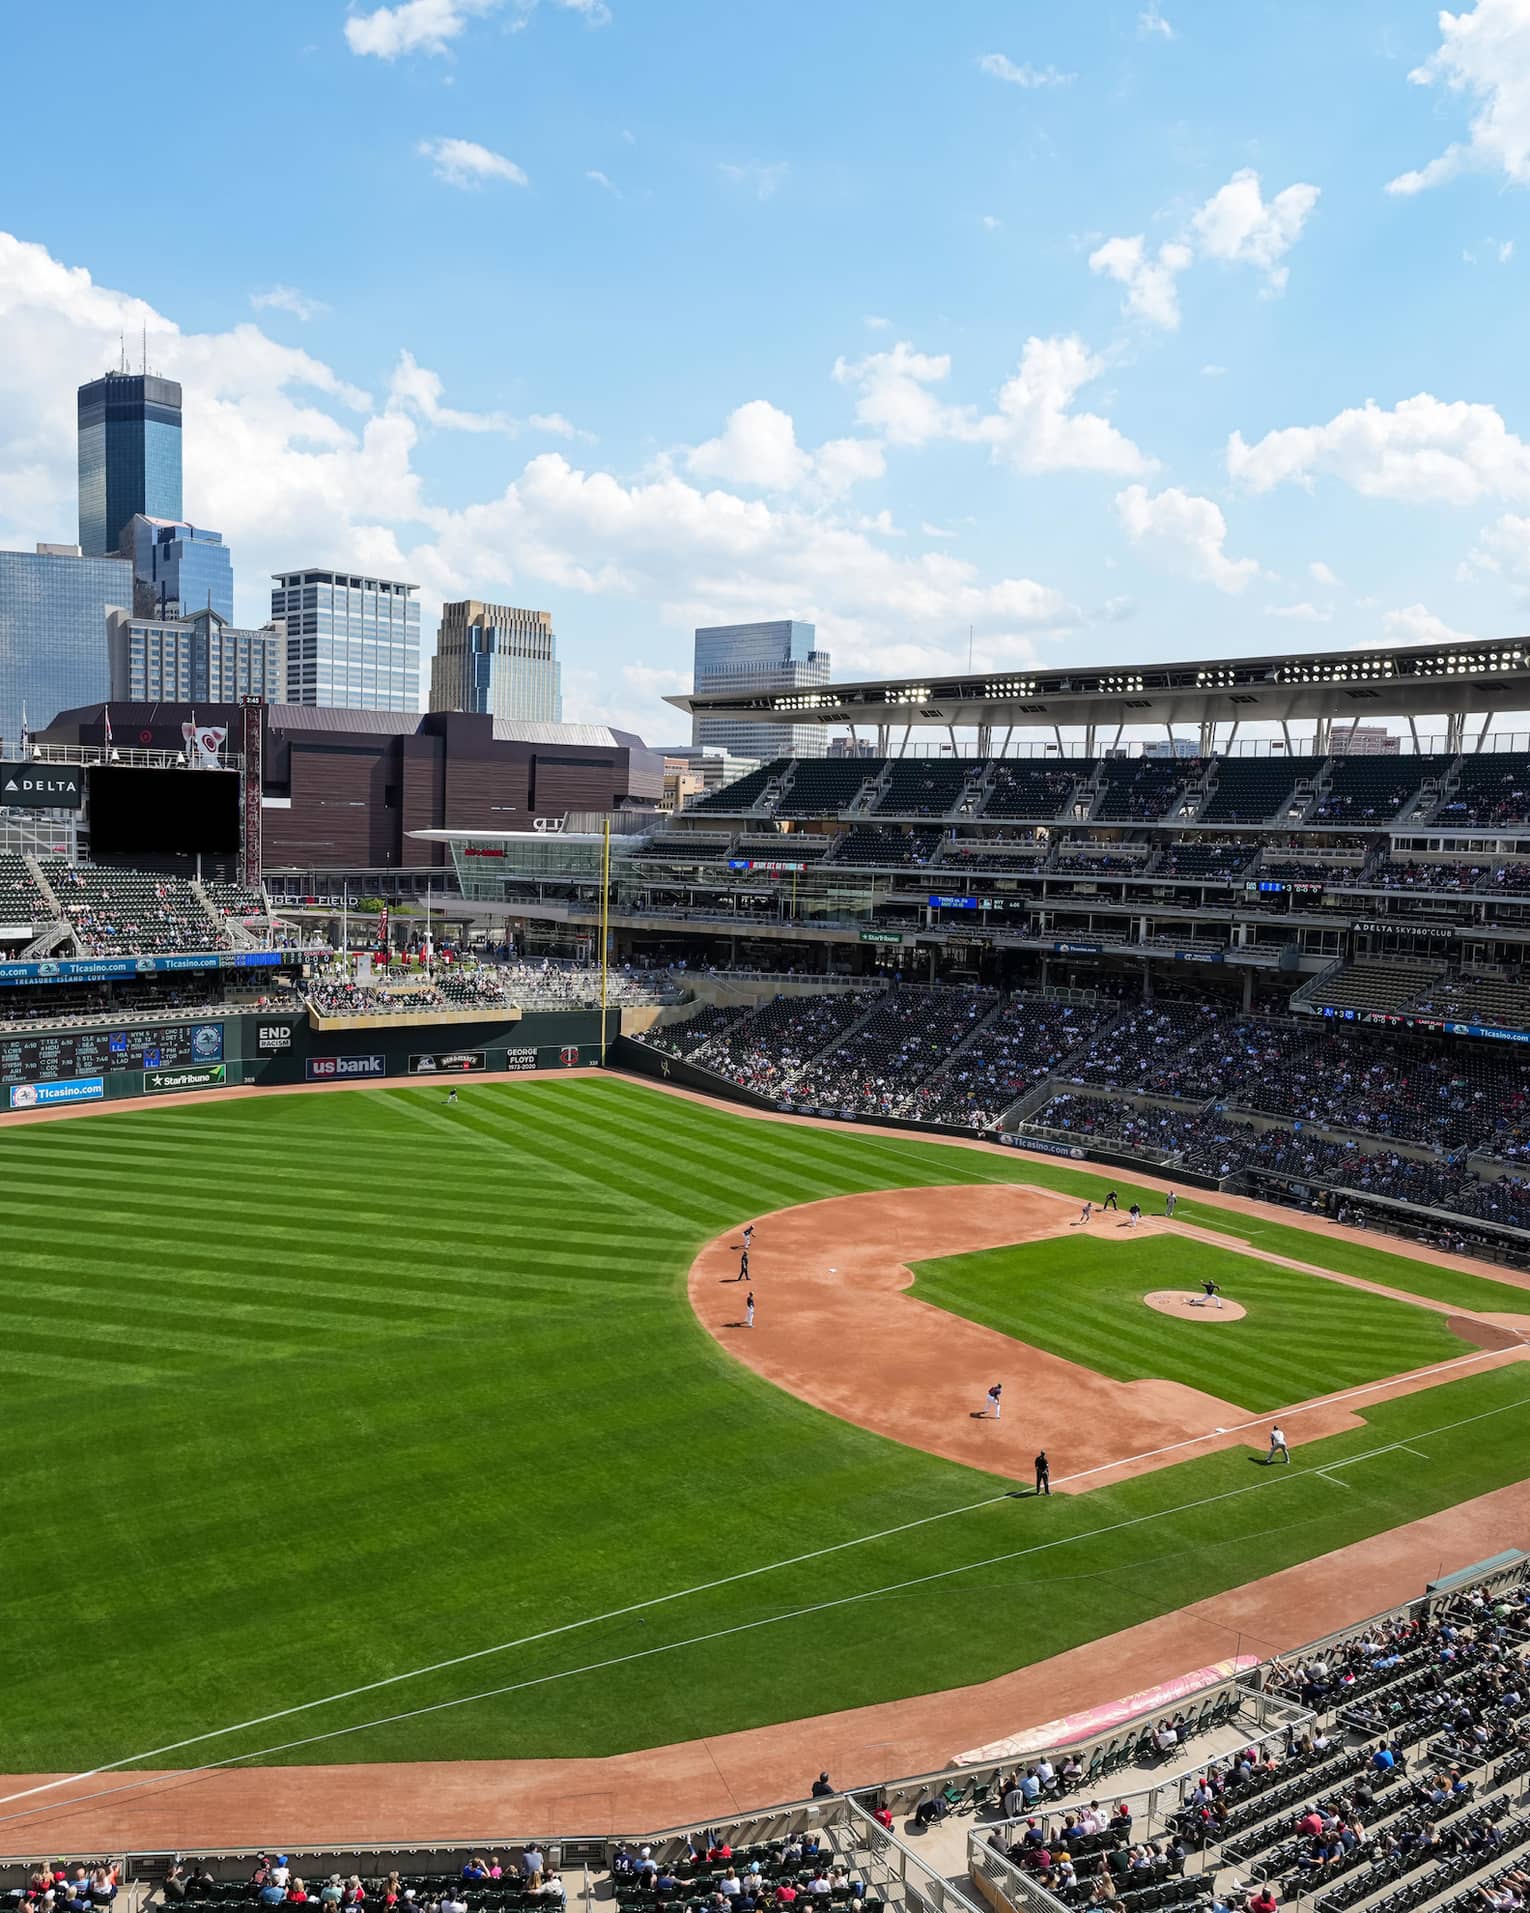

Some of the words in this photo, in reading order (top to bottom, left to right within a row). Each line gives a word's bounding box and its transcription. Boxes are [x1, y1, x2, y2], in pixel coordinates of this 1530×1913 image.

[23, 781, 76, 792] DELTA
[319, 896, 358, 905] FIELD
[1363, 924, 1393, 932] DELTA
[259, 1027, 291, 1039] END
[507, 1048, 537, 1056] GEORGE
[510, 1056, 535, 1064] FLOYD
[615, 1859, 629, 1871] 34
